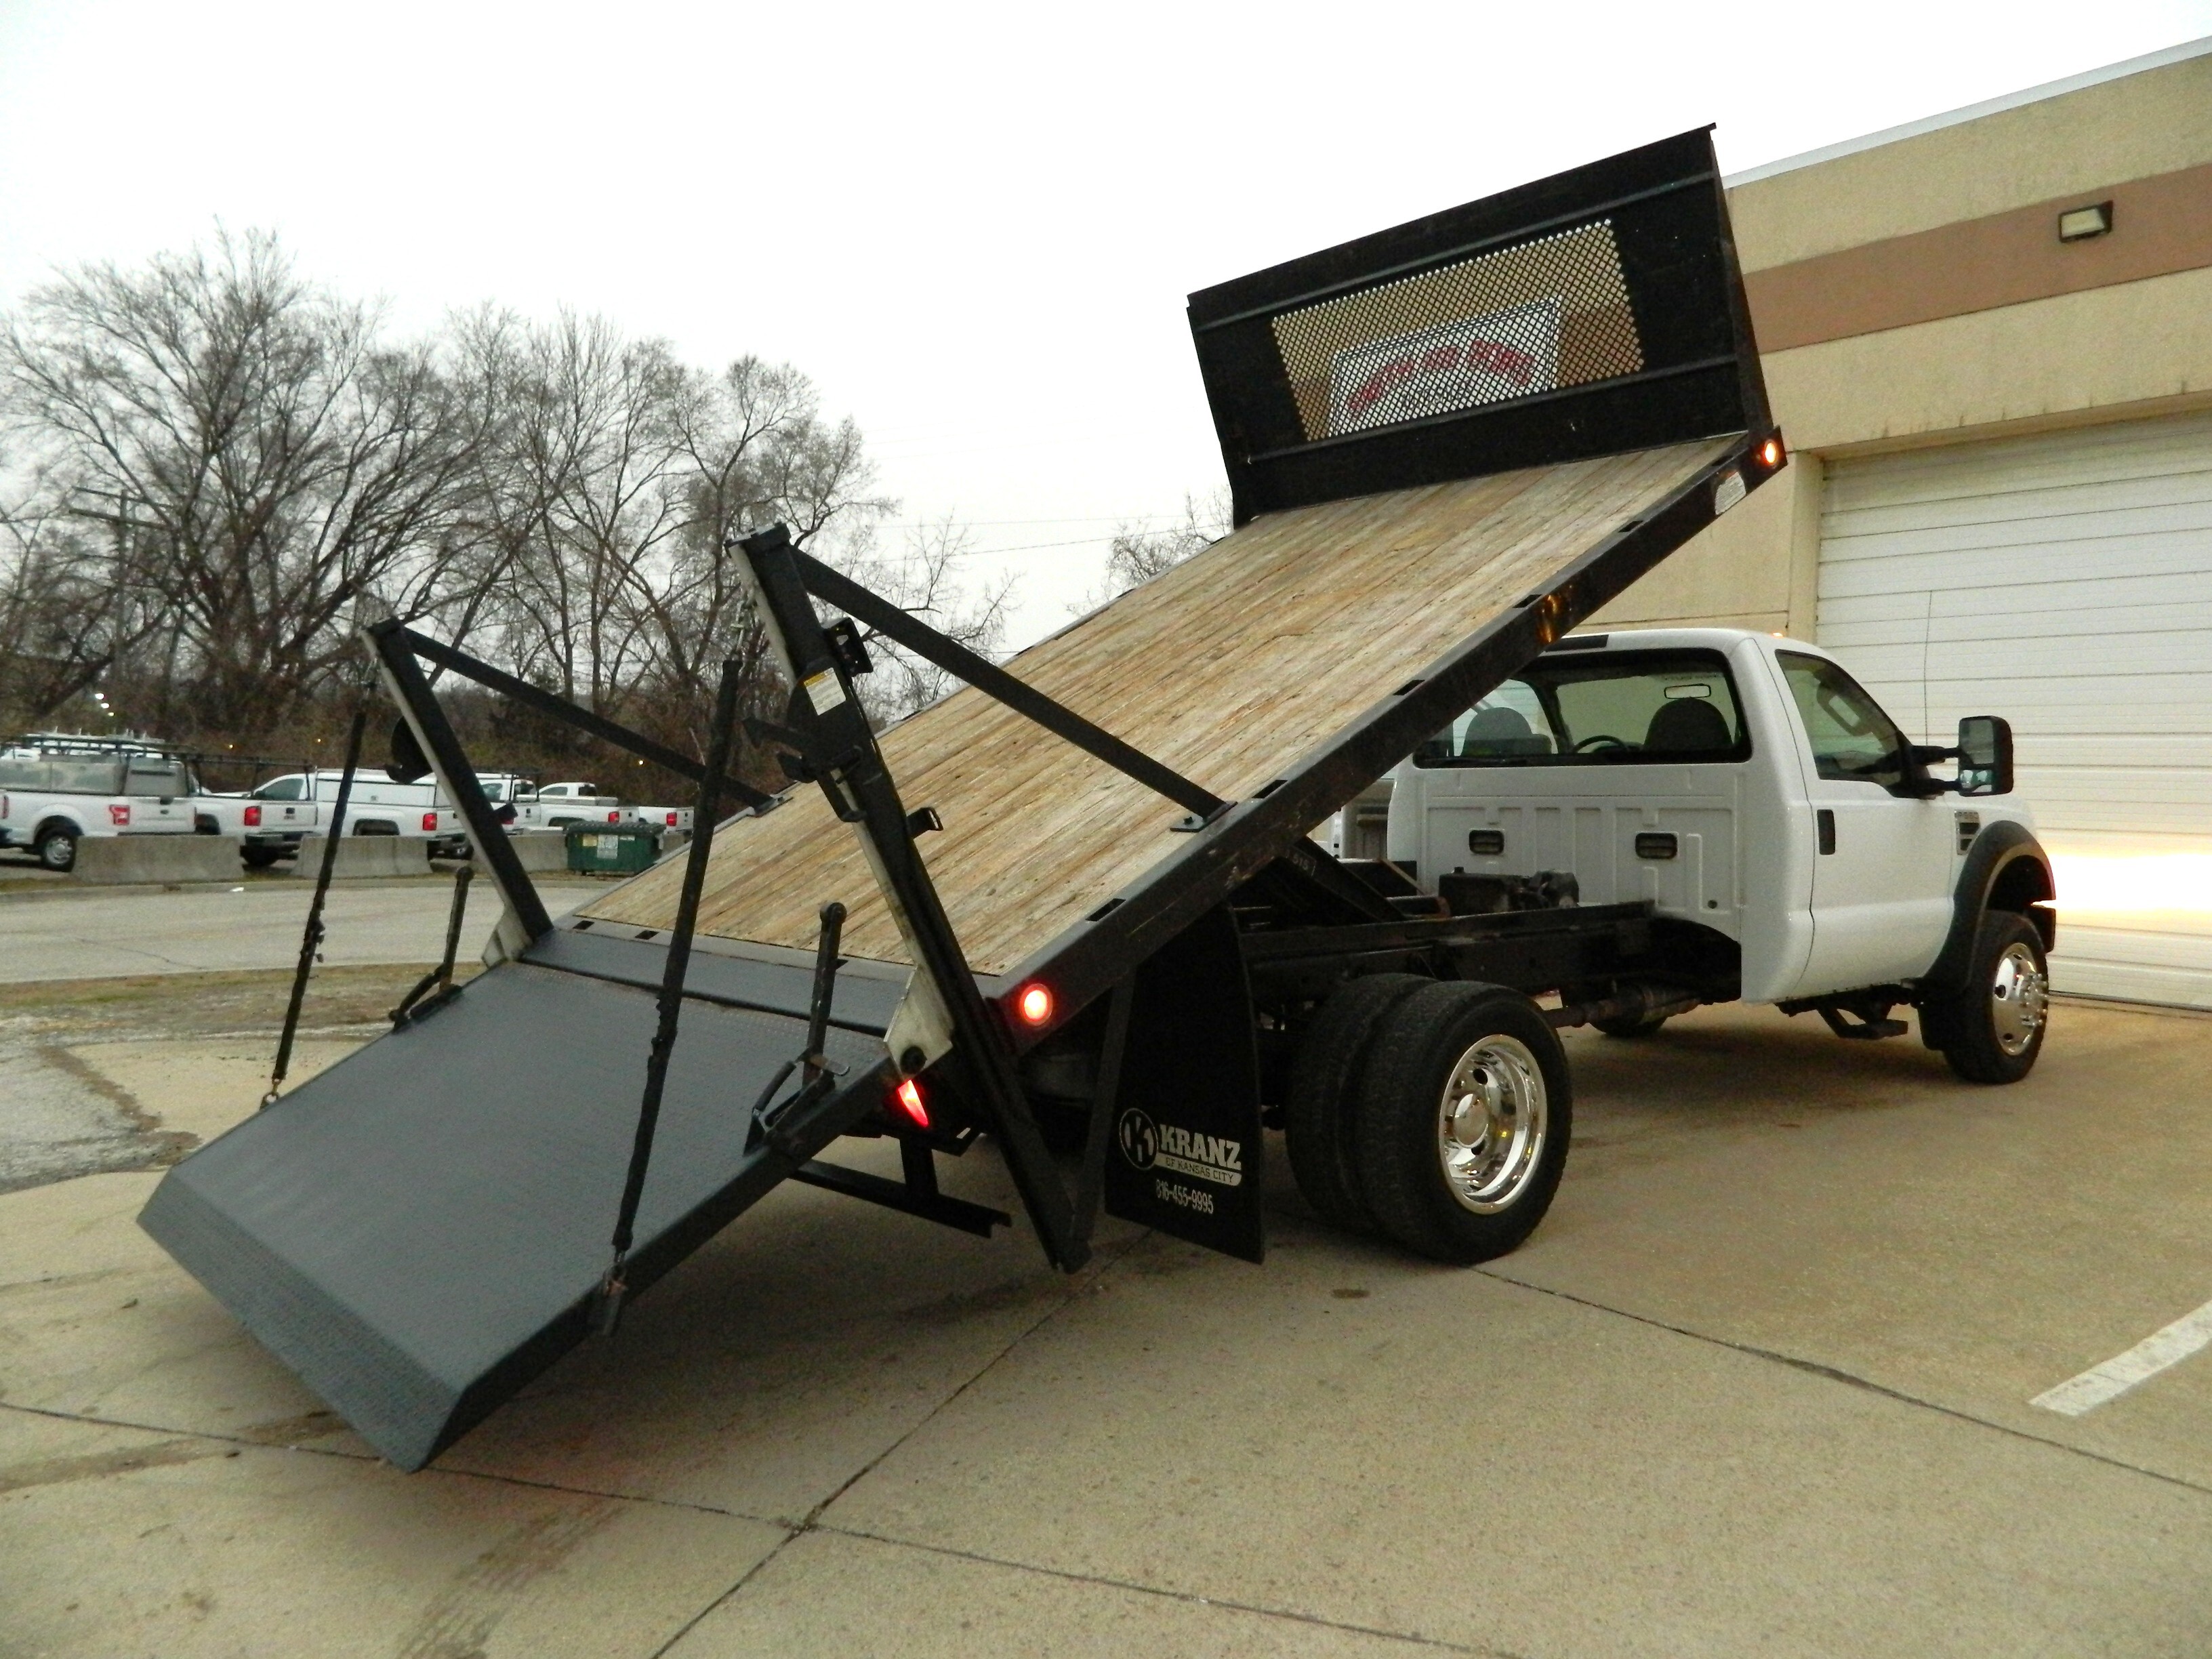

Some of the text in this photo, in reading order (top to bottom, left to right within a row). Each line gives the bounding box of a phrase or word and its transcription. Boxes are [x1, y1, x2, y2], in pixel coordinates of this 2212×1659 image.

[1160, 1124, 1242, 1171] KRANZ
[1166, 1157, 1234, 1183] OF KANSAS CITY
[1156, 1179, 1214, 1215] 816-455-9995
